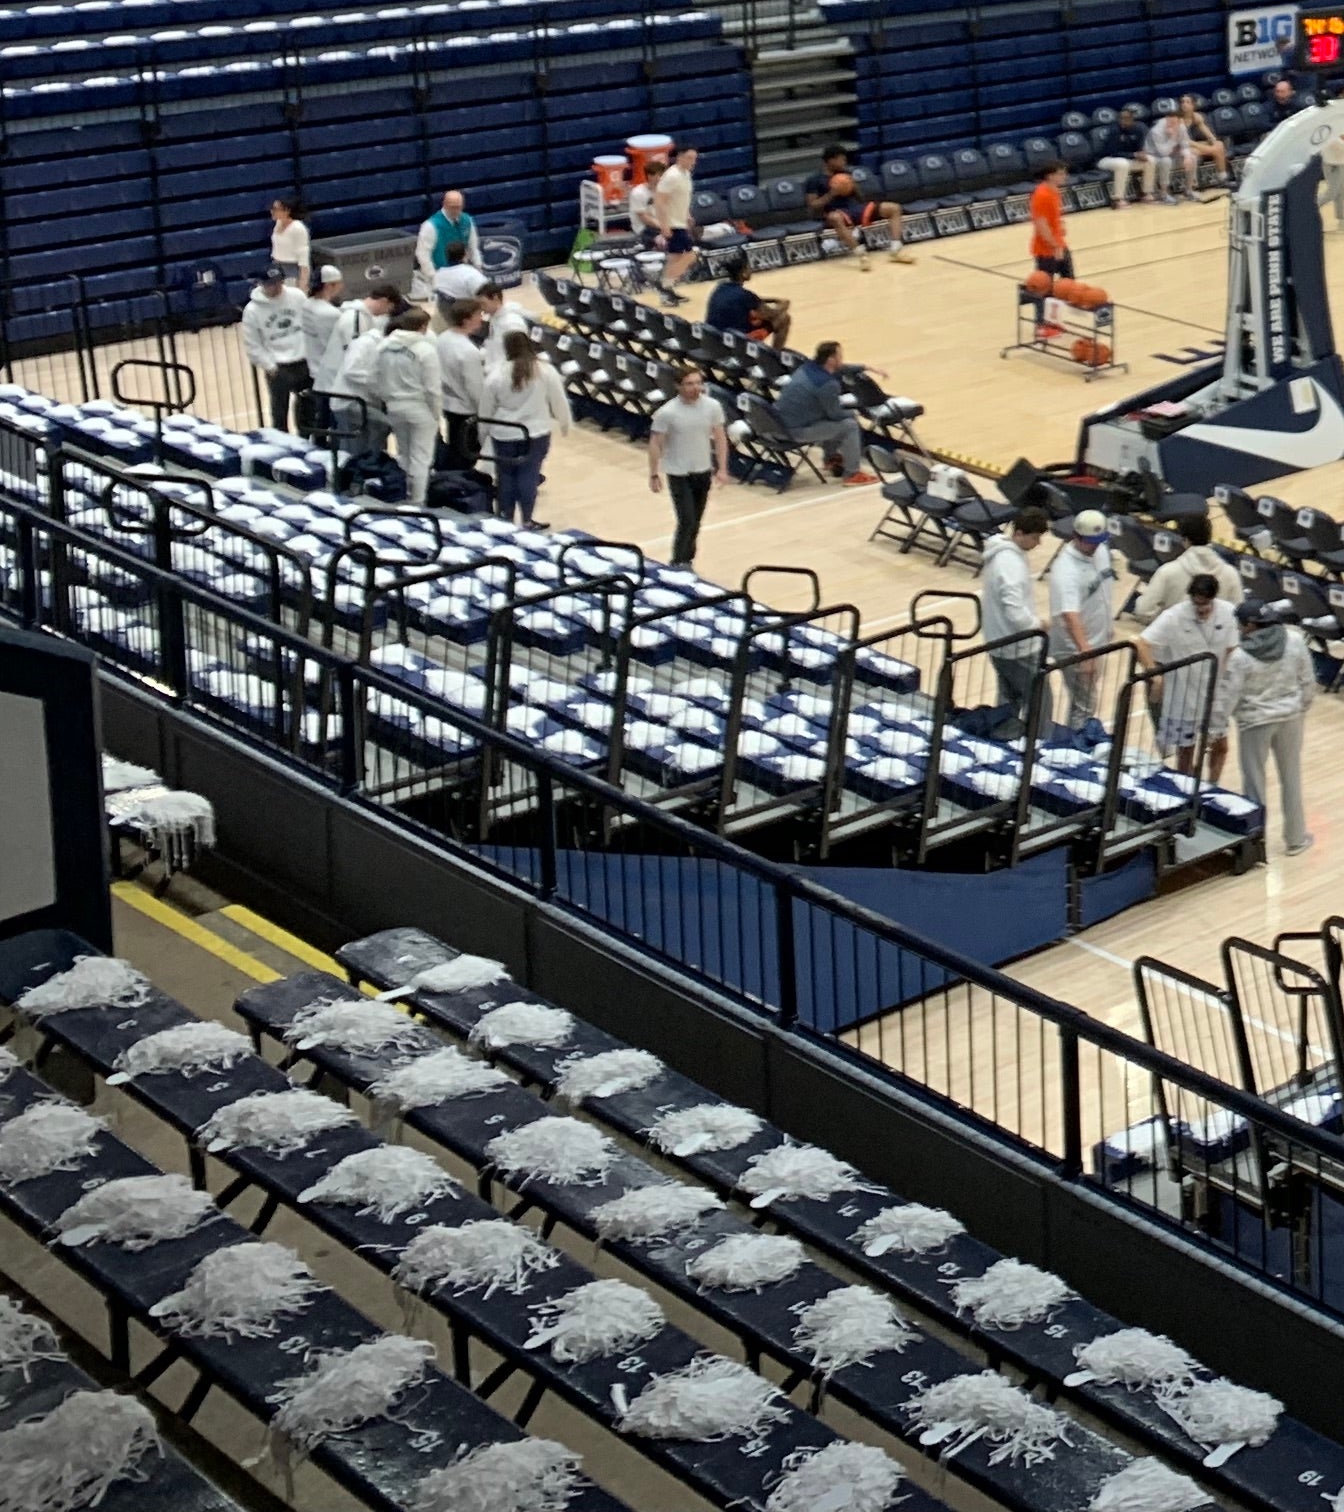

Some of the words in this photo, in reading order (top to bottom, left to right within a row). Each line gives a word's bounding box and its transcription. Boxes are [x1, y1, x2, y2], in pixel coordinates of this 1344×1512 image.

[1310, 36, 1339, 63] 30
[1268, 194, 1280, 248] STATE
[1269, 250, 1281, 296] PENN
[1298, 1470, 1322, 1487] 19
